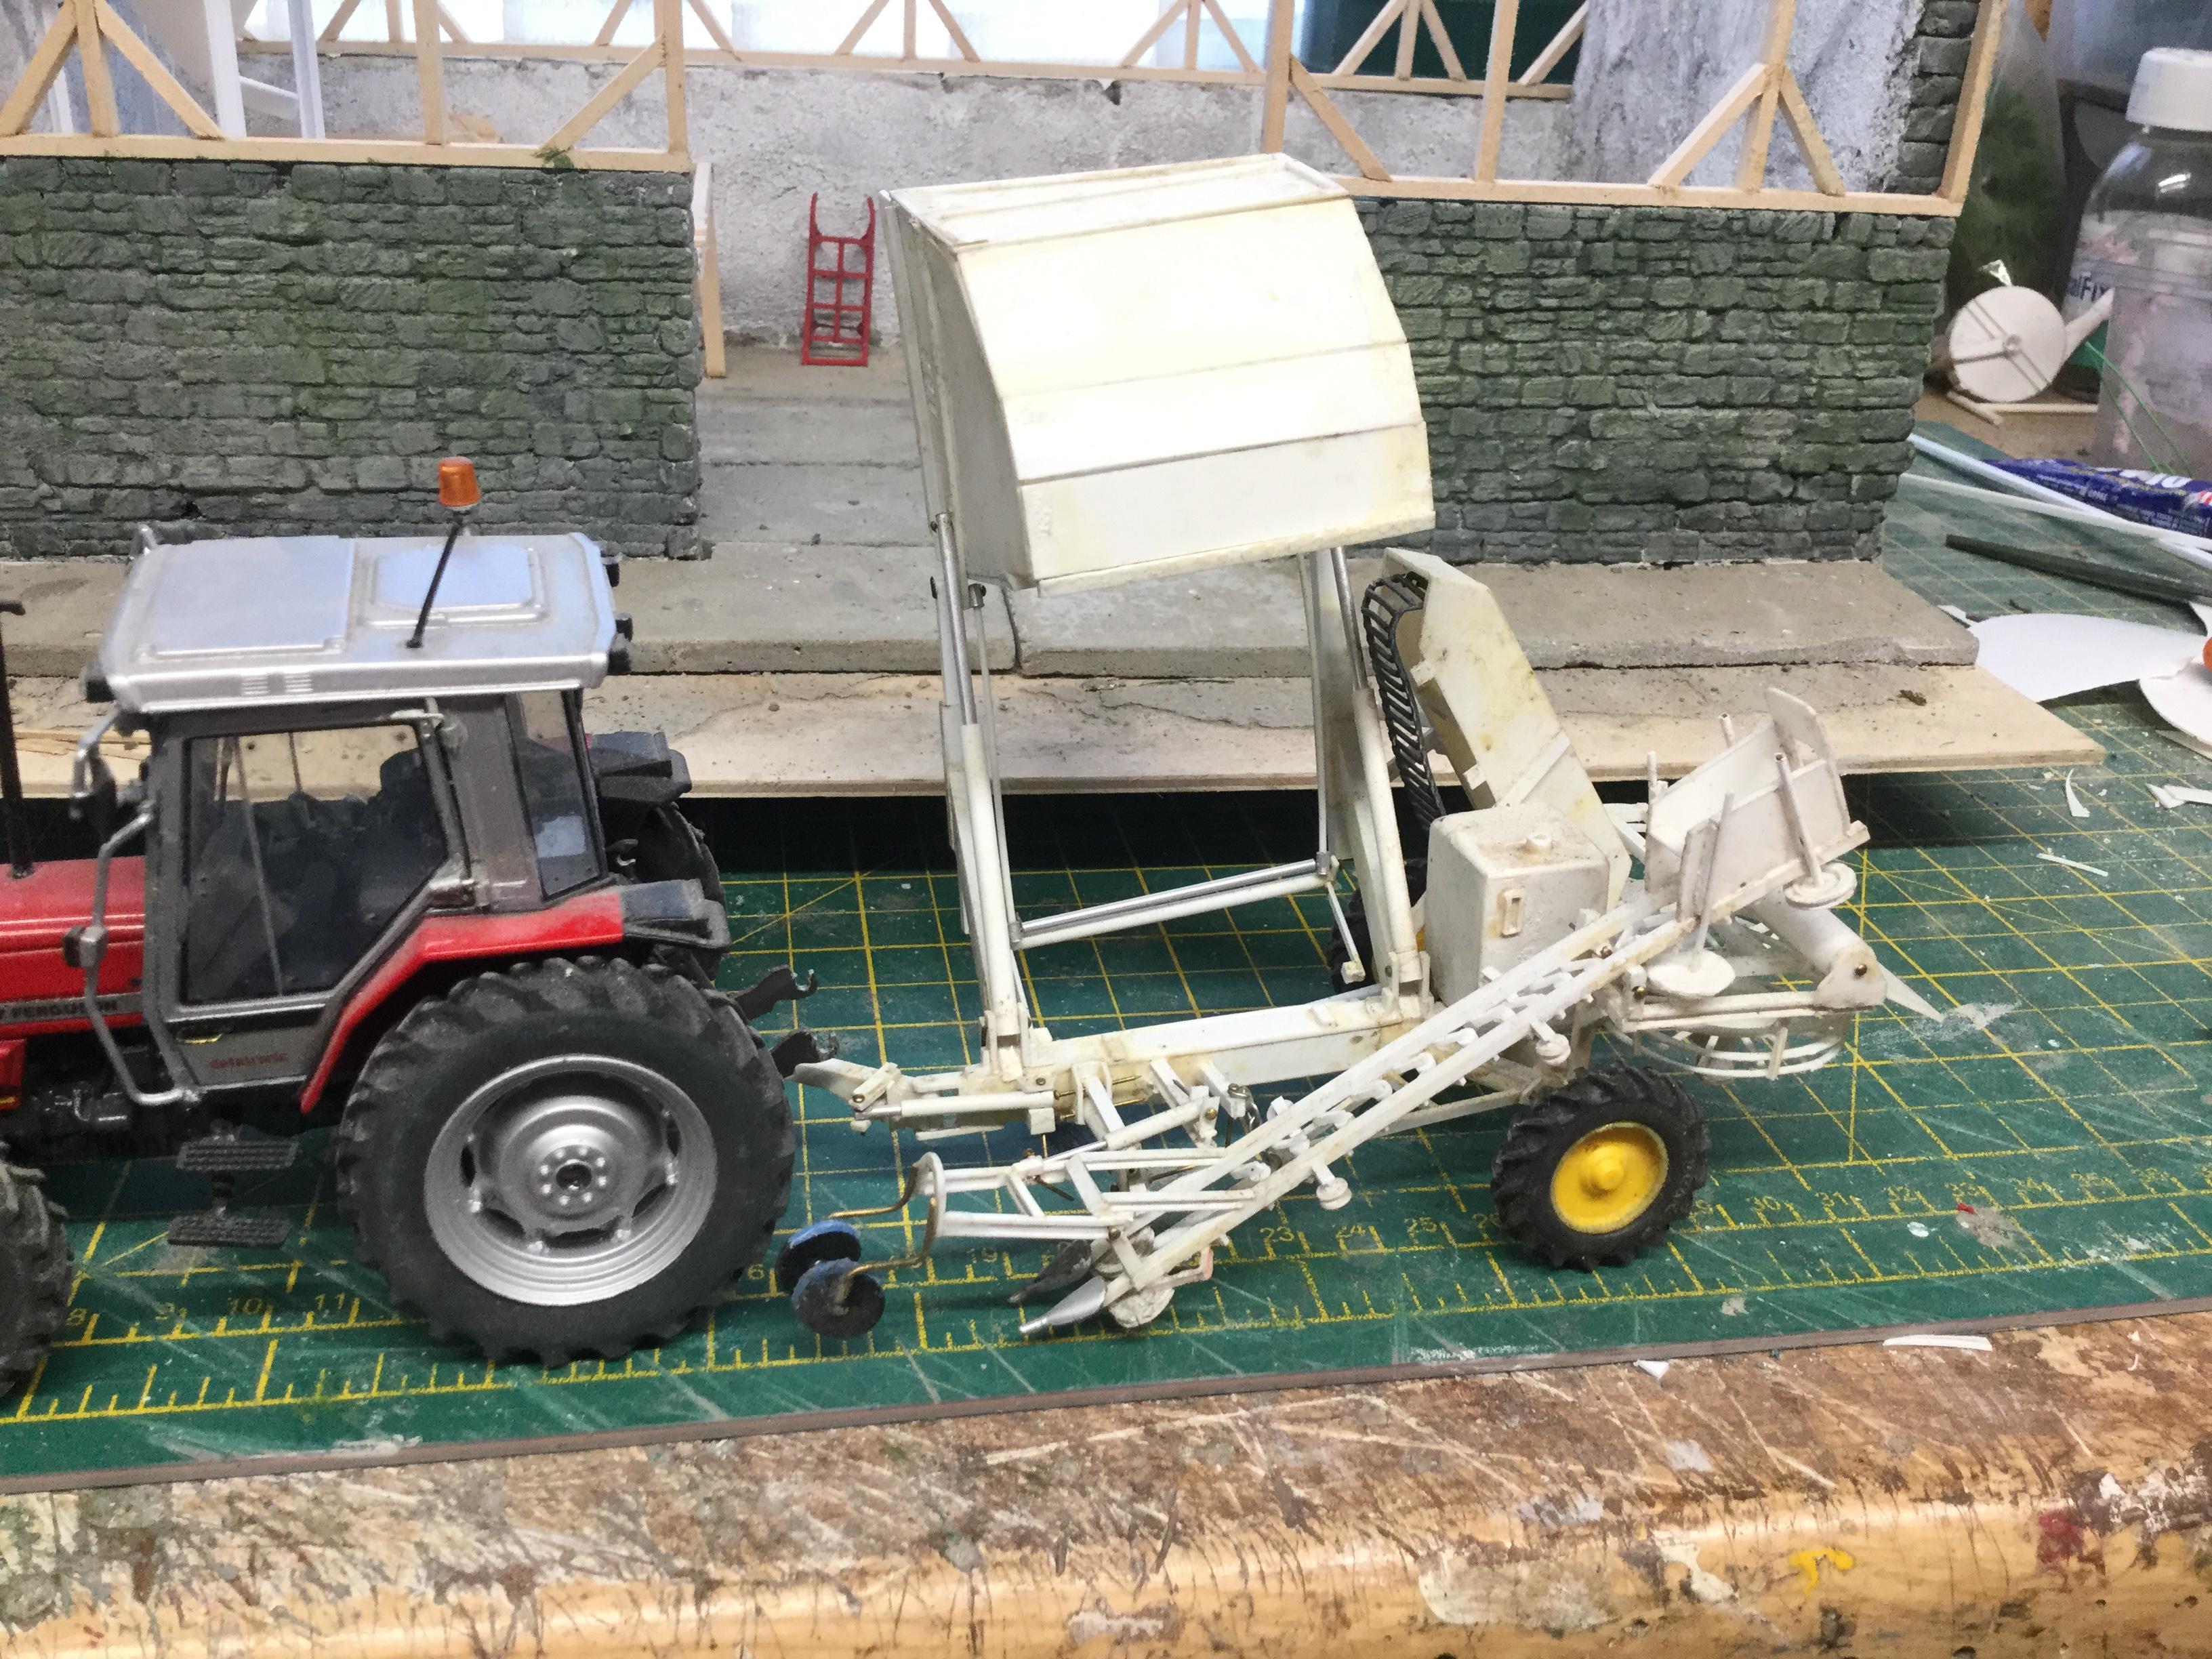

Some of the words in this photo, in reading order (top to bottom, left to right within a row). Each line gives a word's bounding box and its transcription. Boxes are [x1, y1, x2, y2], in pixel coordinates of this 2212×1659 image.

[66, 1307, 87, 1326] 8
[228, 1296, 264, 1315] 10
[315, 1292, 346, 1311] 11
[1261, 1225, 1295, 1242] 23
